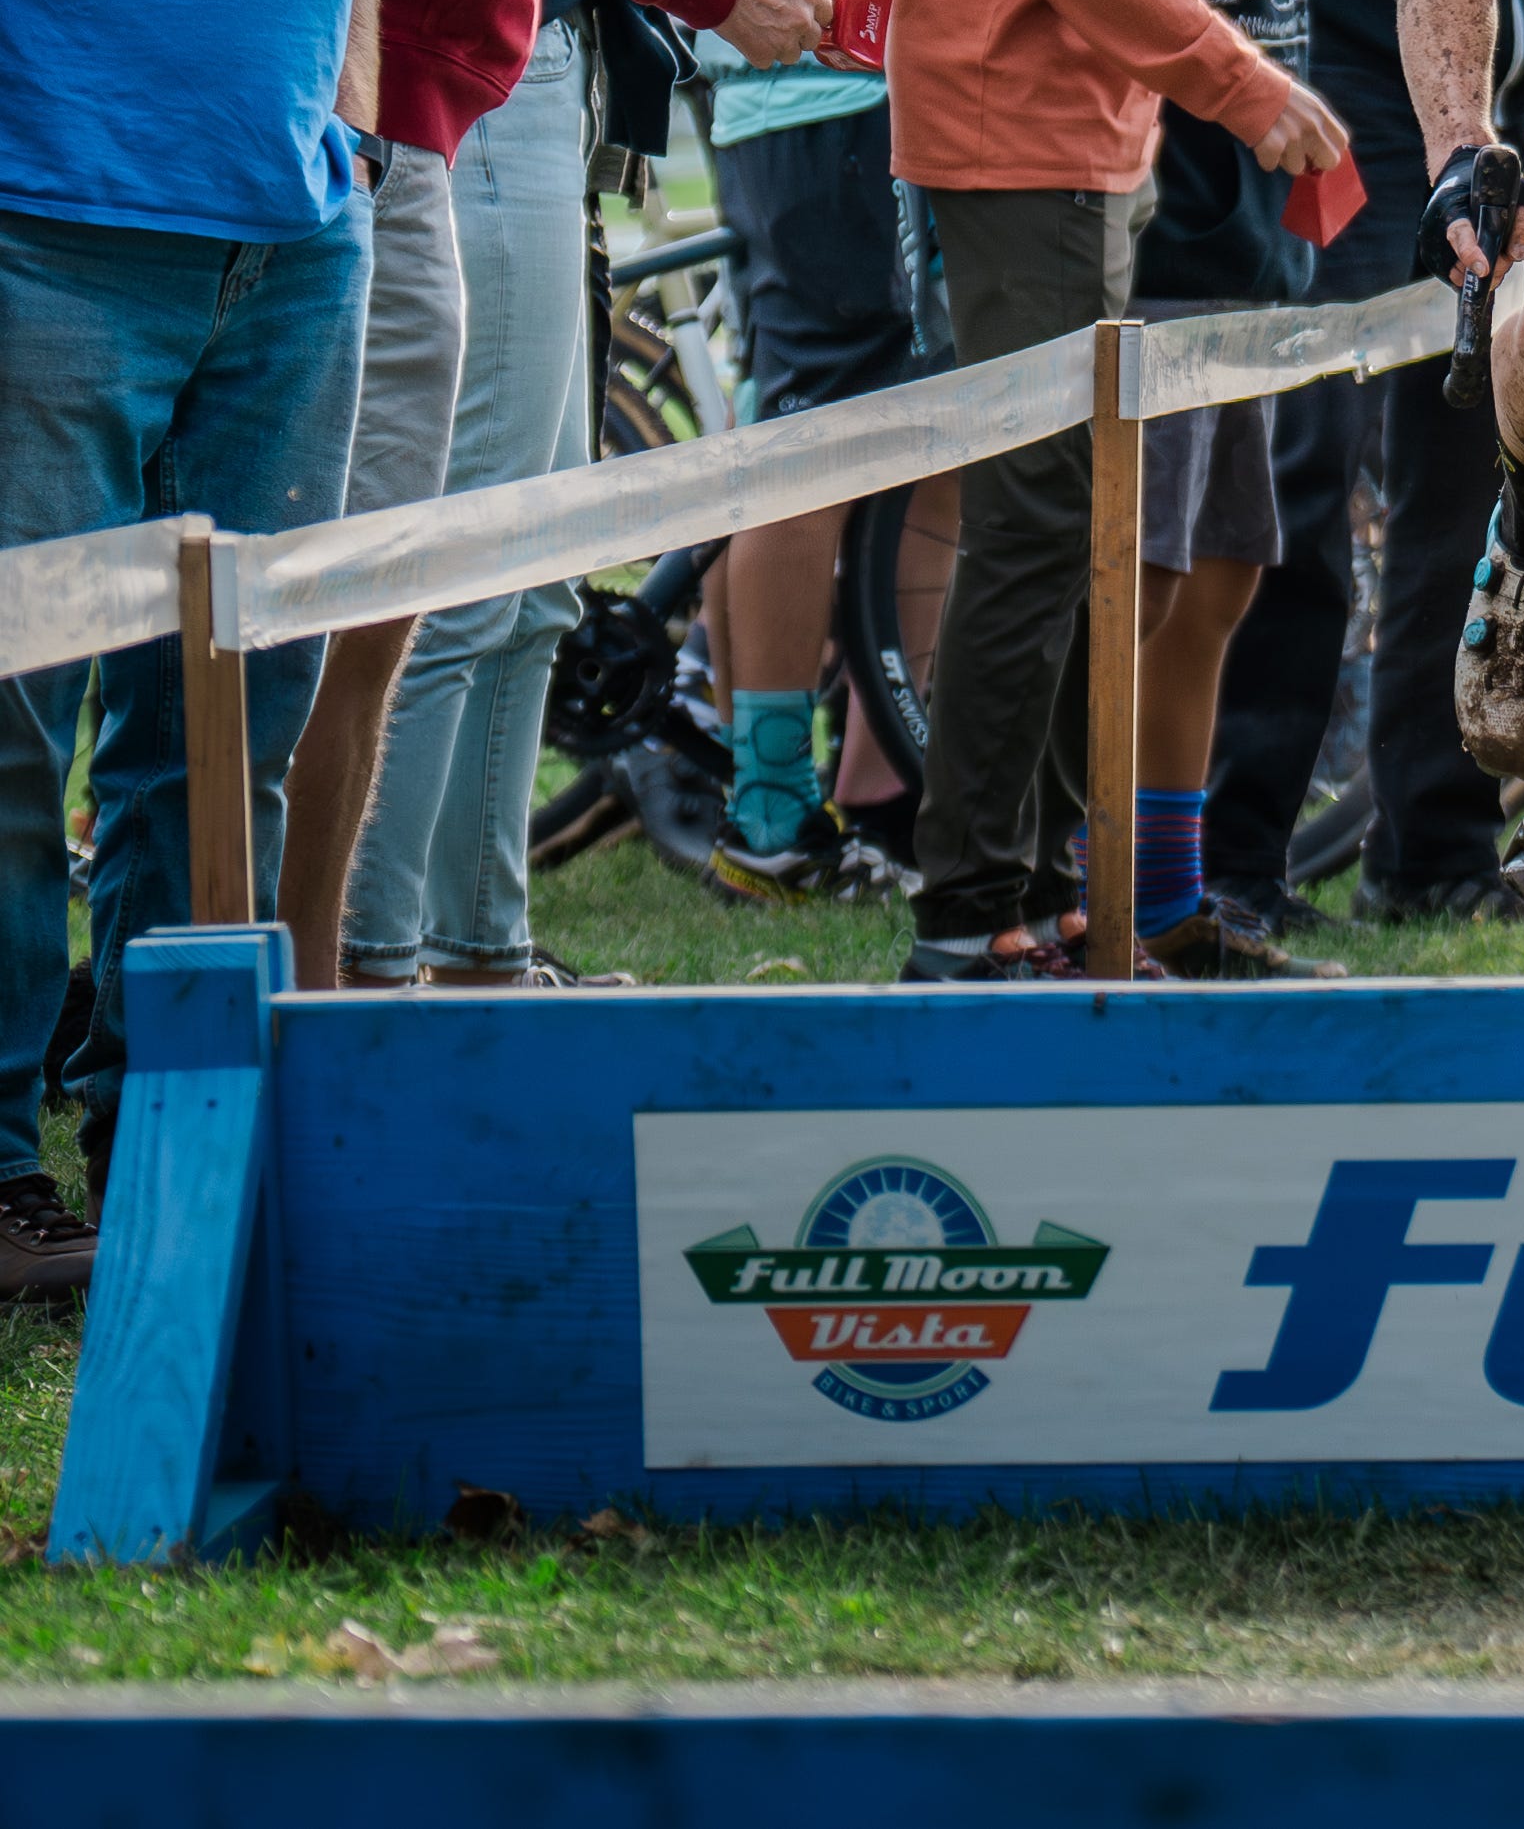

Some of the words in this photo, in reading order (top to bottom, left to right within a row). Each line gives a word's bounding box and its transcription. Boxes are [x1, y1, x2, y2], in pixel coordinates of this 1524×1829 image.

[879, 649, 906, 684] DT
[730, 1256, 871, 1294] Full
[880, 1254, 1074, 1293] Moon
[810, 1312, 996, 1351] Vista
[817, 1373, 873, 1415] BIKE
[880, 1400, 898, 1419] &
[904, 1373, 984, 1419] SPORT
